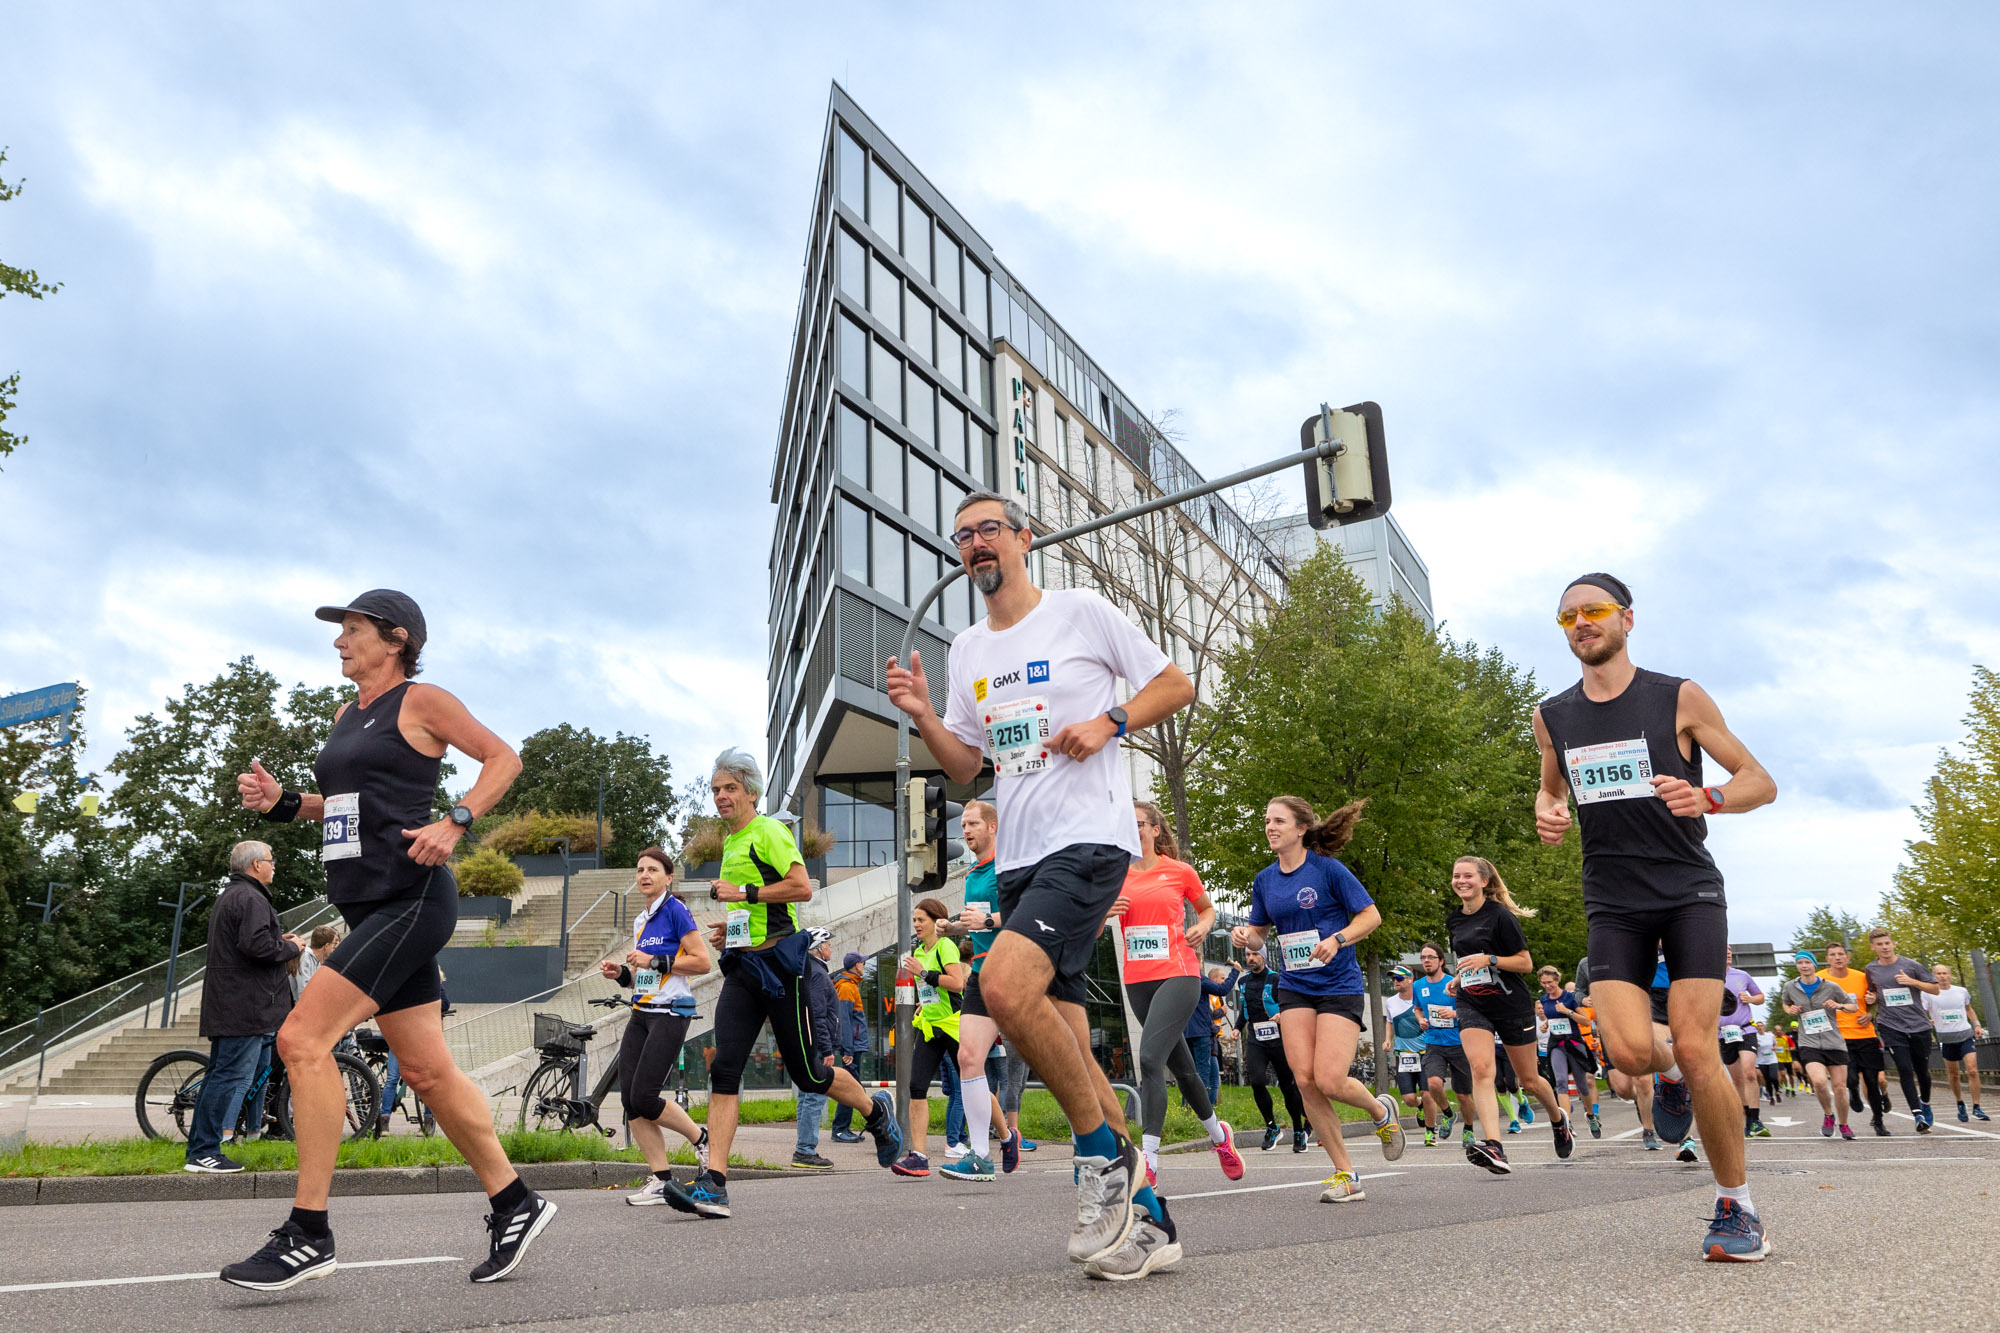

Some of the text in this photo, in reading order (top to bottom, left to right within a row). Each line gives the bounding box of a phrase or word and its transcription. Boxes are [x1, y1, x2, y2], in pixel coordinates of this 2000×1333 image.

[1012, 378, 1026, 494] PARK
[1028, 664, 1047, 678] 1&1
[993, 670, 1021, 689] GMX
[996, 722, 1031, 747] 2751
[1025, 759, 1046, 770] 2751
[1585, 764, 1633, 785] 3156
[1597, 788, 1626, 799] Jannik
[1133, 939, 1159, 950] 1709
[1288, 946, 1312, 959] 1703
